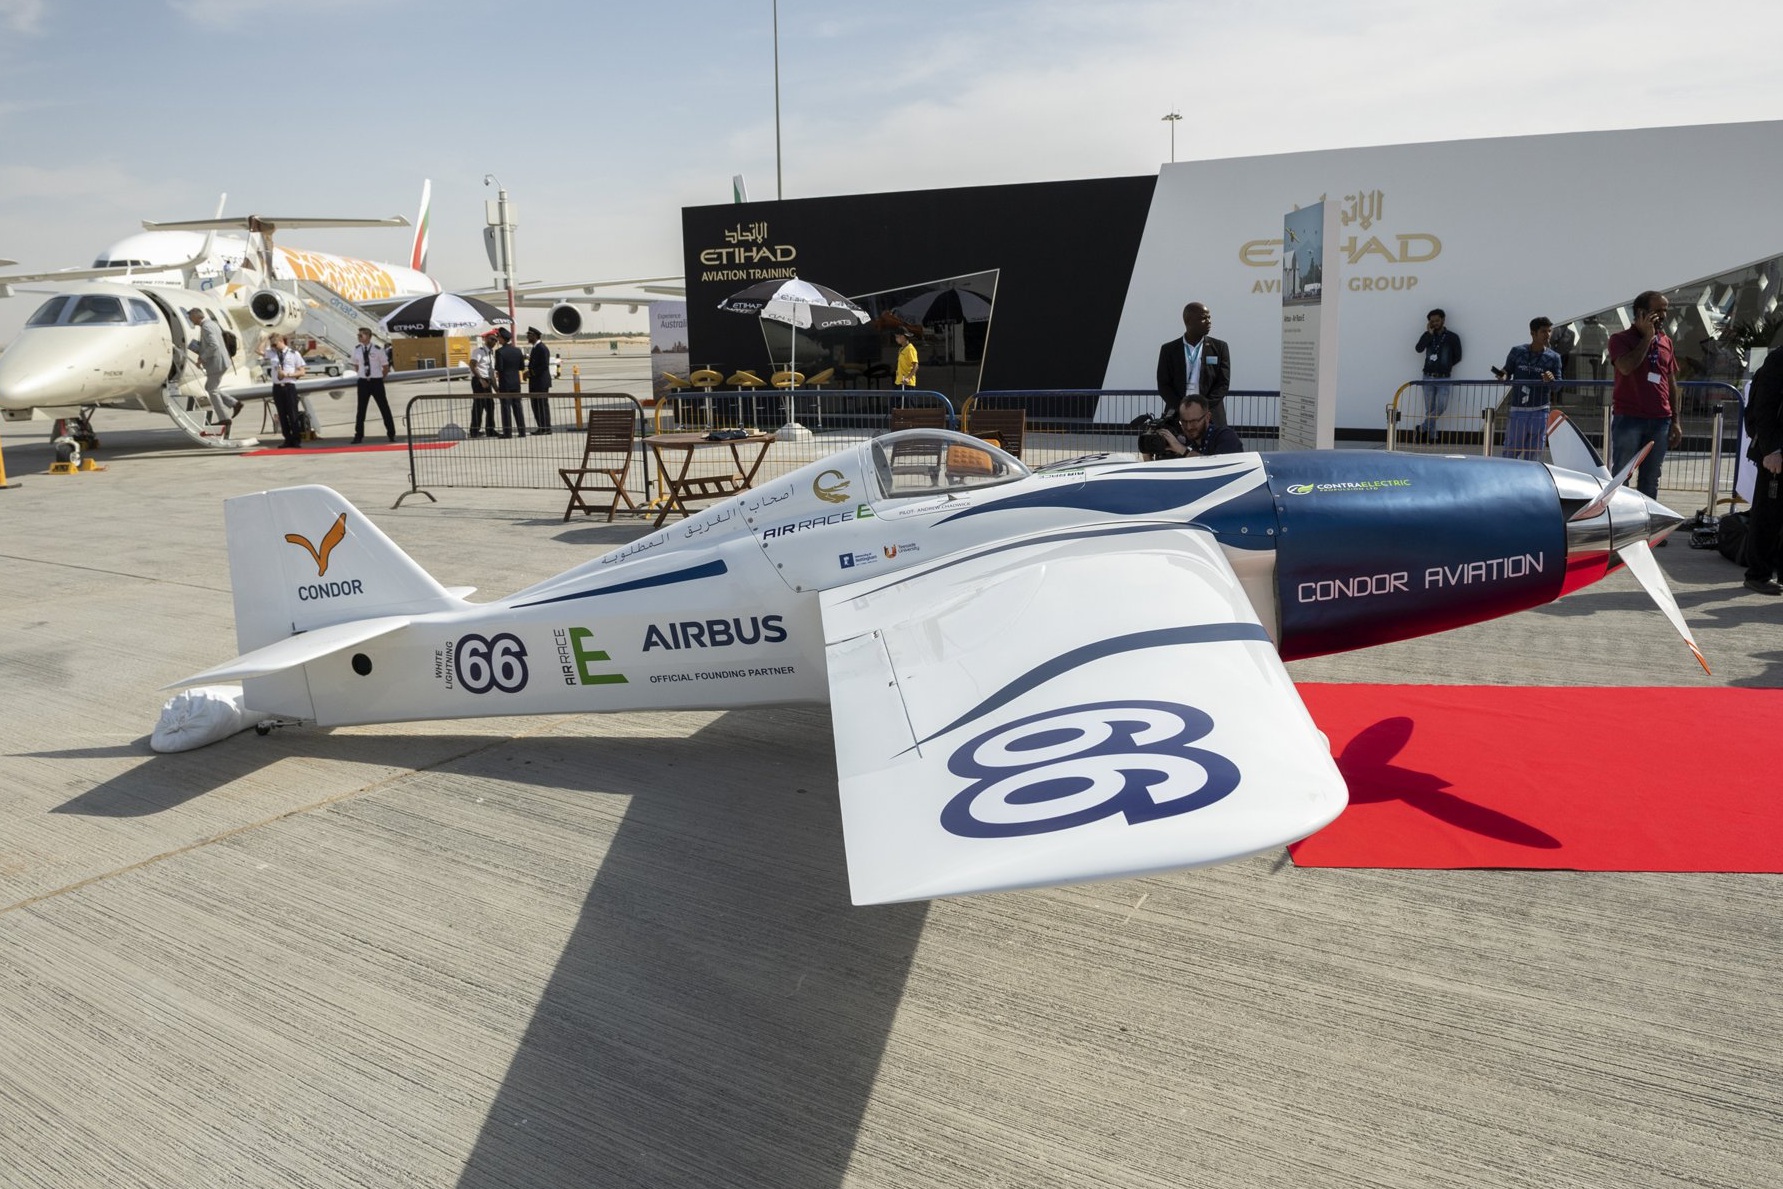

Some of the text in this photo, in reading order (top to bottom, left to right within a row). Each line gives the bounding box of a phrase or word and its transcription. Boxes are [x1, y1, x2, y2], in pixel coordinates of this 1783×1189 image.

[700, 245, 797, 265] ETIHAD
[1238, 233, 1442, 267] EHAD
[702, 267, 797, 282] AVIATION TRAINING
[1347, 276, 1419, 292] GROUP
[330, 297, 359, 319] dnata
[393, 323, 425, 332] ETIHAD
[660, 319, 688, 329] Australi
[1316, 479, 1412, 490] CONTRAELECTRIC
[1298, 551, 1544, 602] CONDOR AVIATION
[298, 579, 364, 601] CONDOR
[642, 615, 788, 652] AIRBUS
[435, 650, 443, 679] WHITE
[445, 641, 453, 690] LIGHTNING
[454, 632, 529, 695] 66
[650, 666, 795, 683] OFFICIAL FOUNDING PARTNER
[939, 699, 1242, 839] 66
